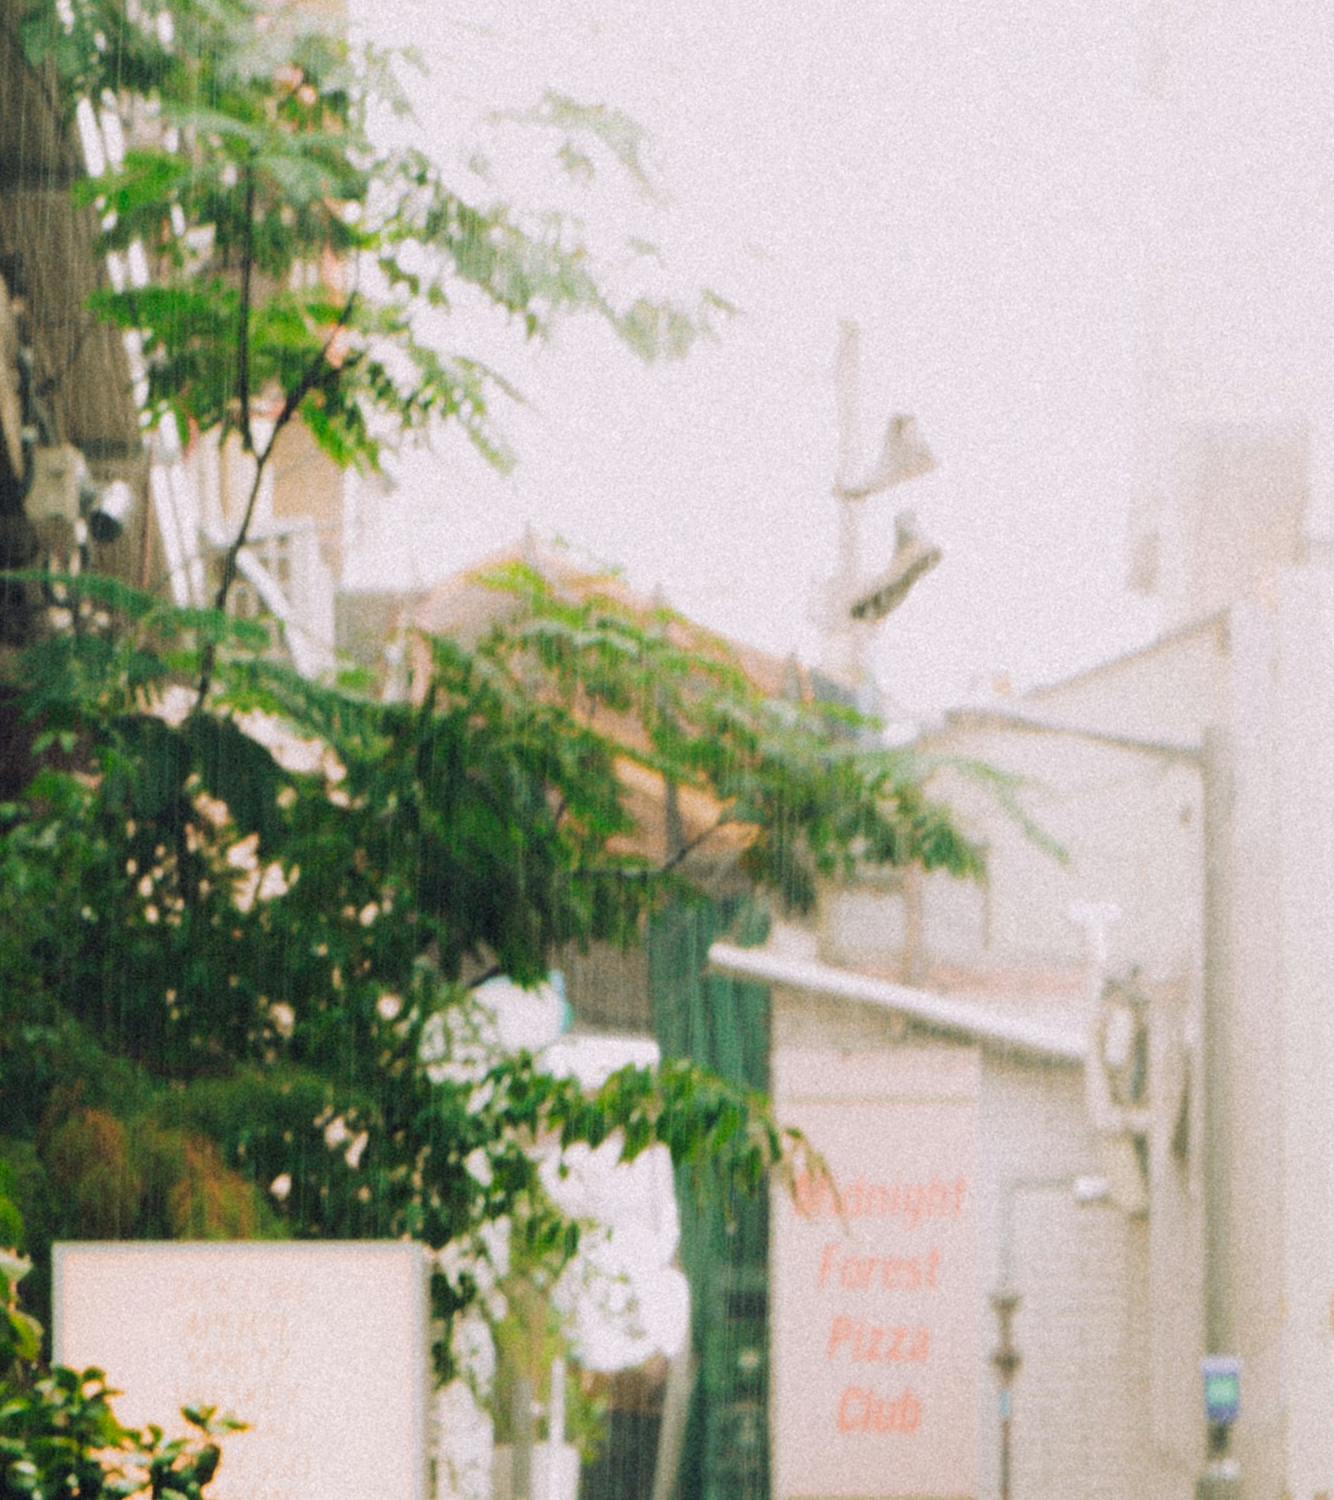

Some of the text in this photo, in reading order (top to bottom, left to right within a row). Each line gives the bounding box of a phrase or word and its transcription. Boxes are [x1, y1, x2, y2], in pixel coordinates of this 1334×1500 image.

[816, 1242, 942, 1291] Forest
[825, 1313, 932, 1363] Pizza
[835, 1384, 924, 1435] Club
